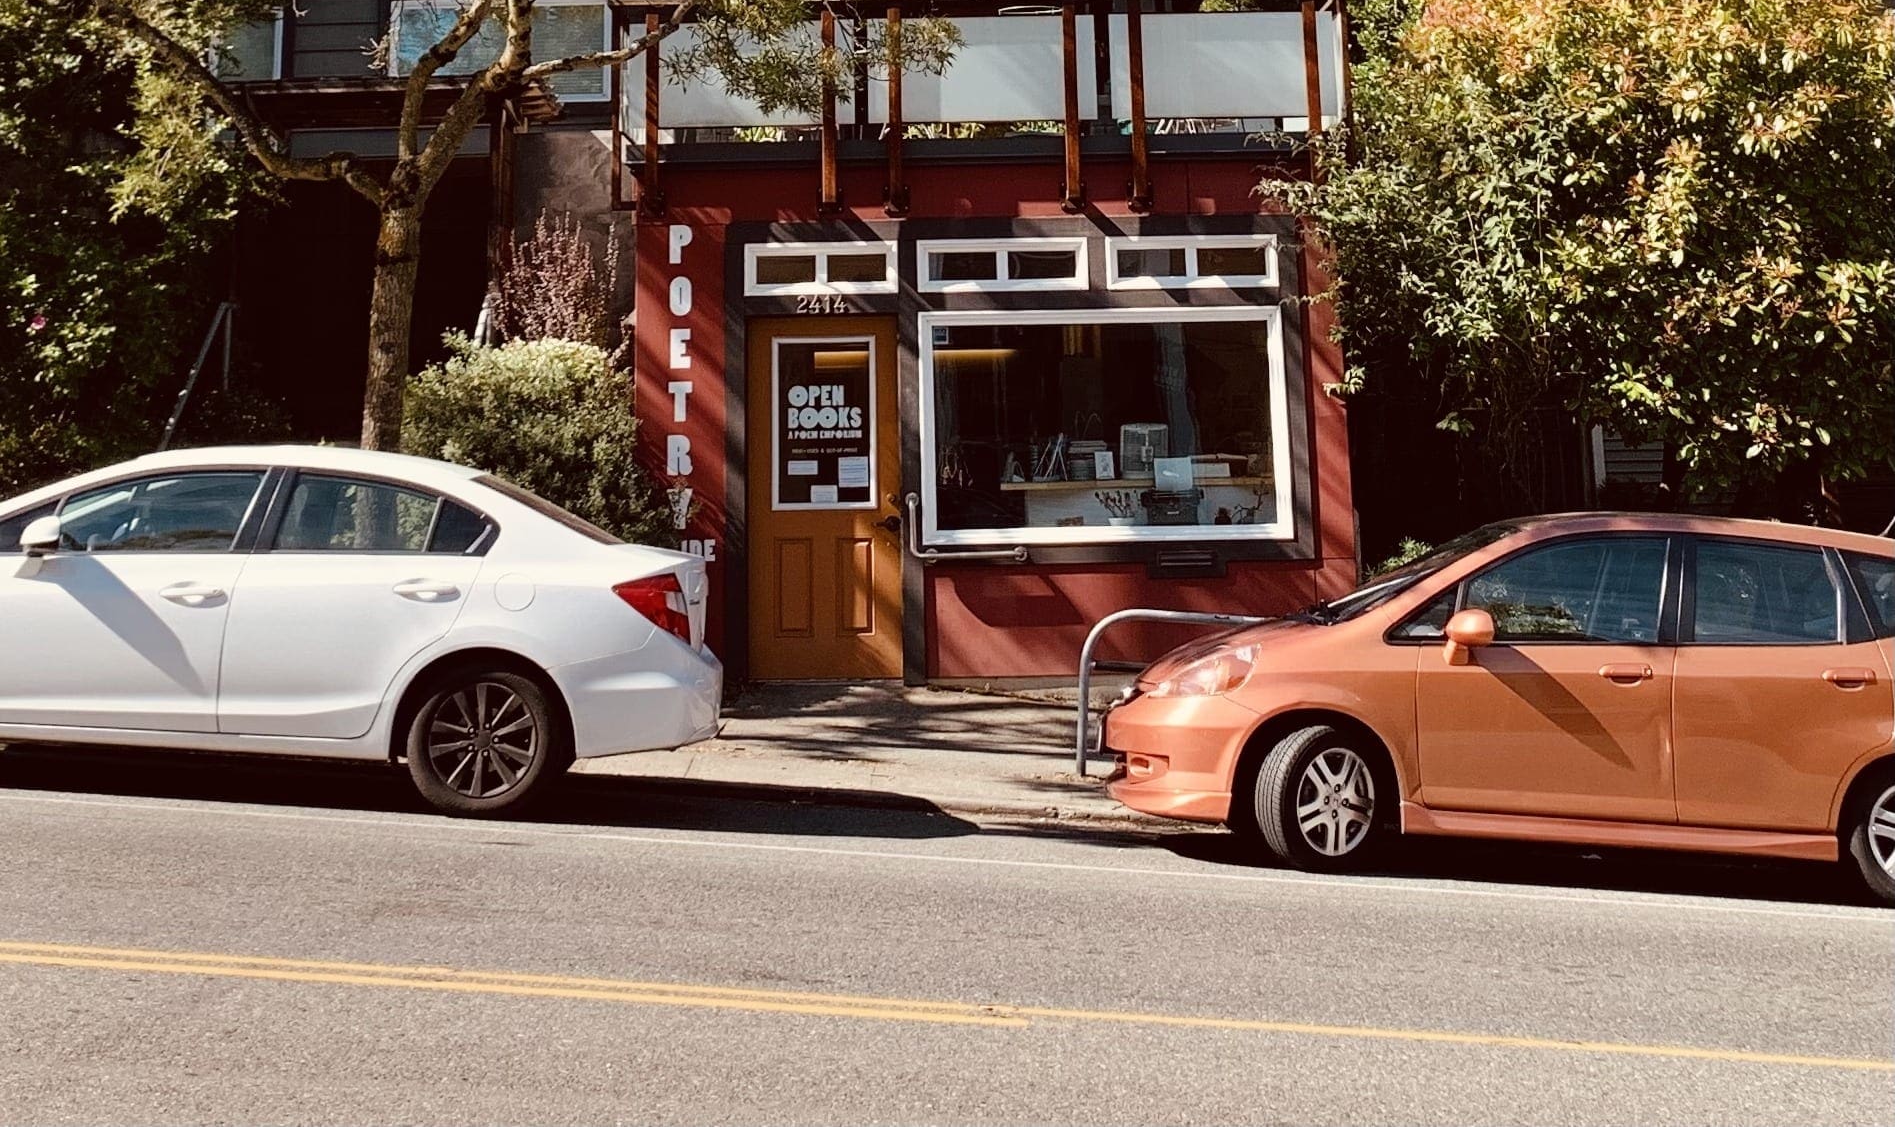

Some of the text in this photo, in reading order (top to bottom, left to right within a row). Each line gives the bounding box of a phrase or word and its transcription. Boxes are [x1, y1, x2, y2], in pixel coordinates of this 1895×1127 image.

[796, 294, 847, 314] 2414
[668, 224, 693, 530] POETRY
[787, 385, 845, 407] OPEN
[787, 407, 862, 429] BOOKS
